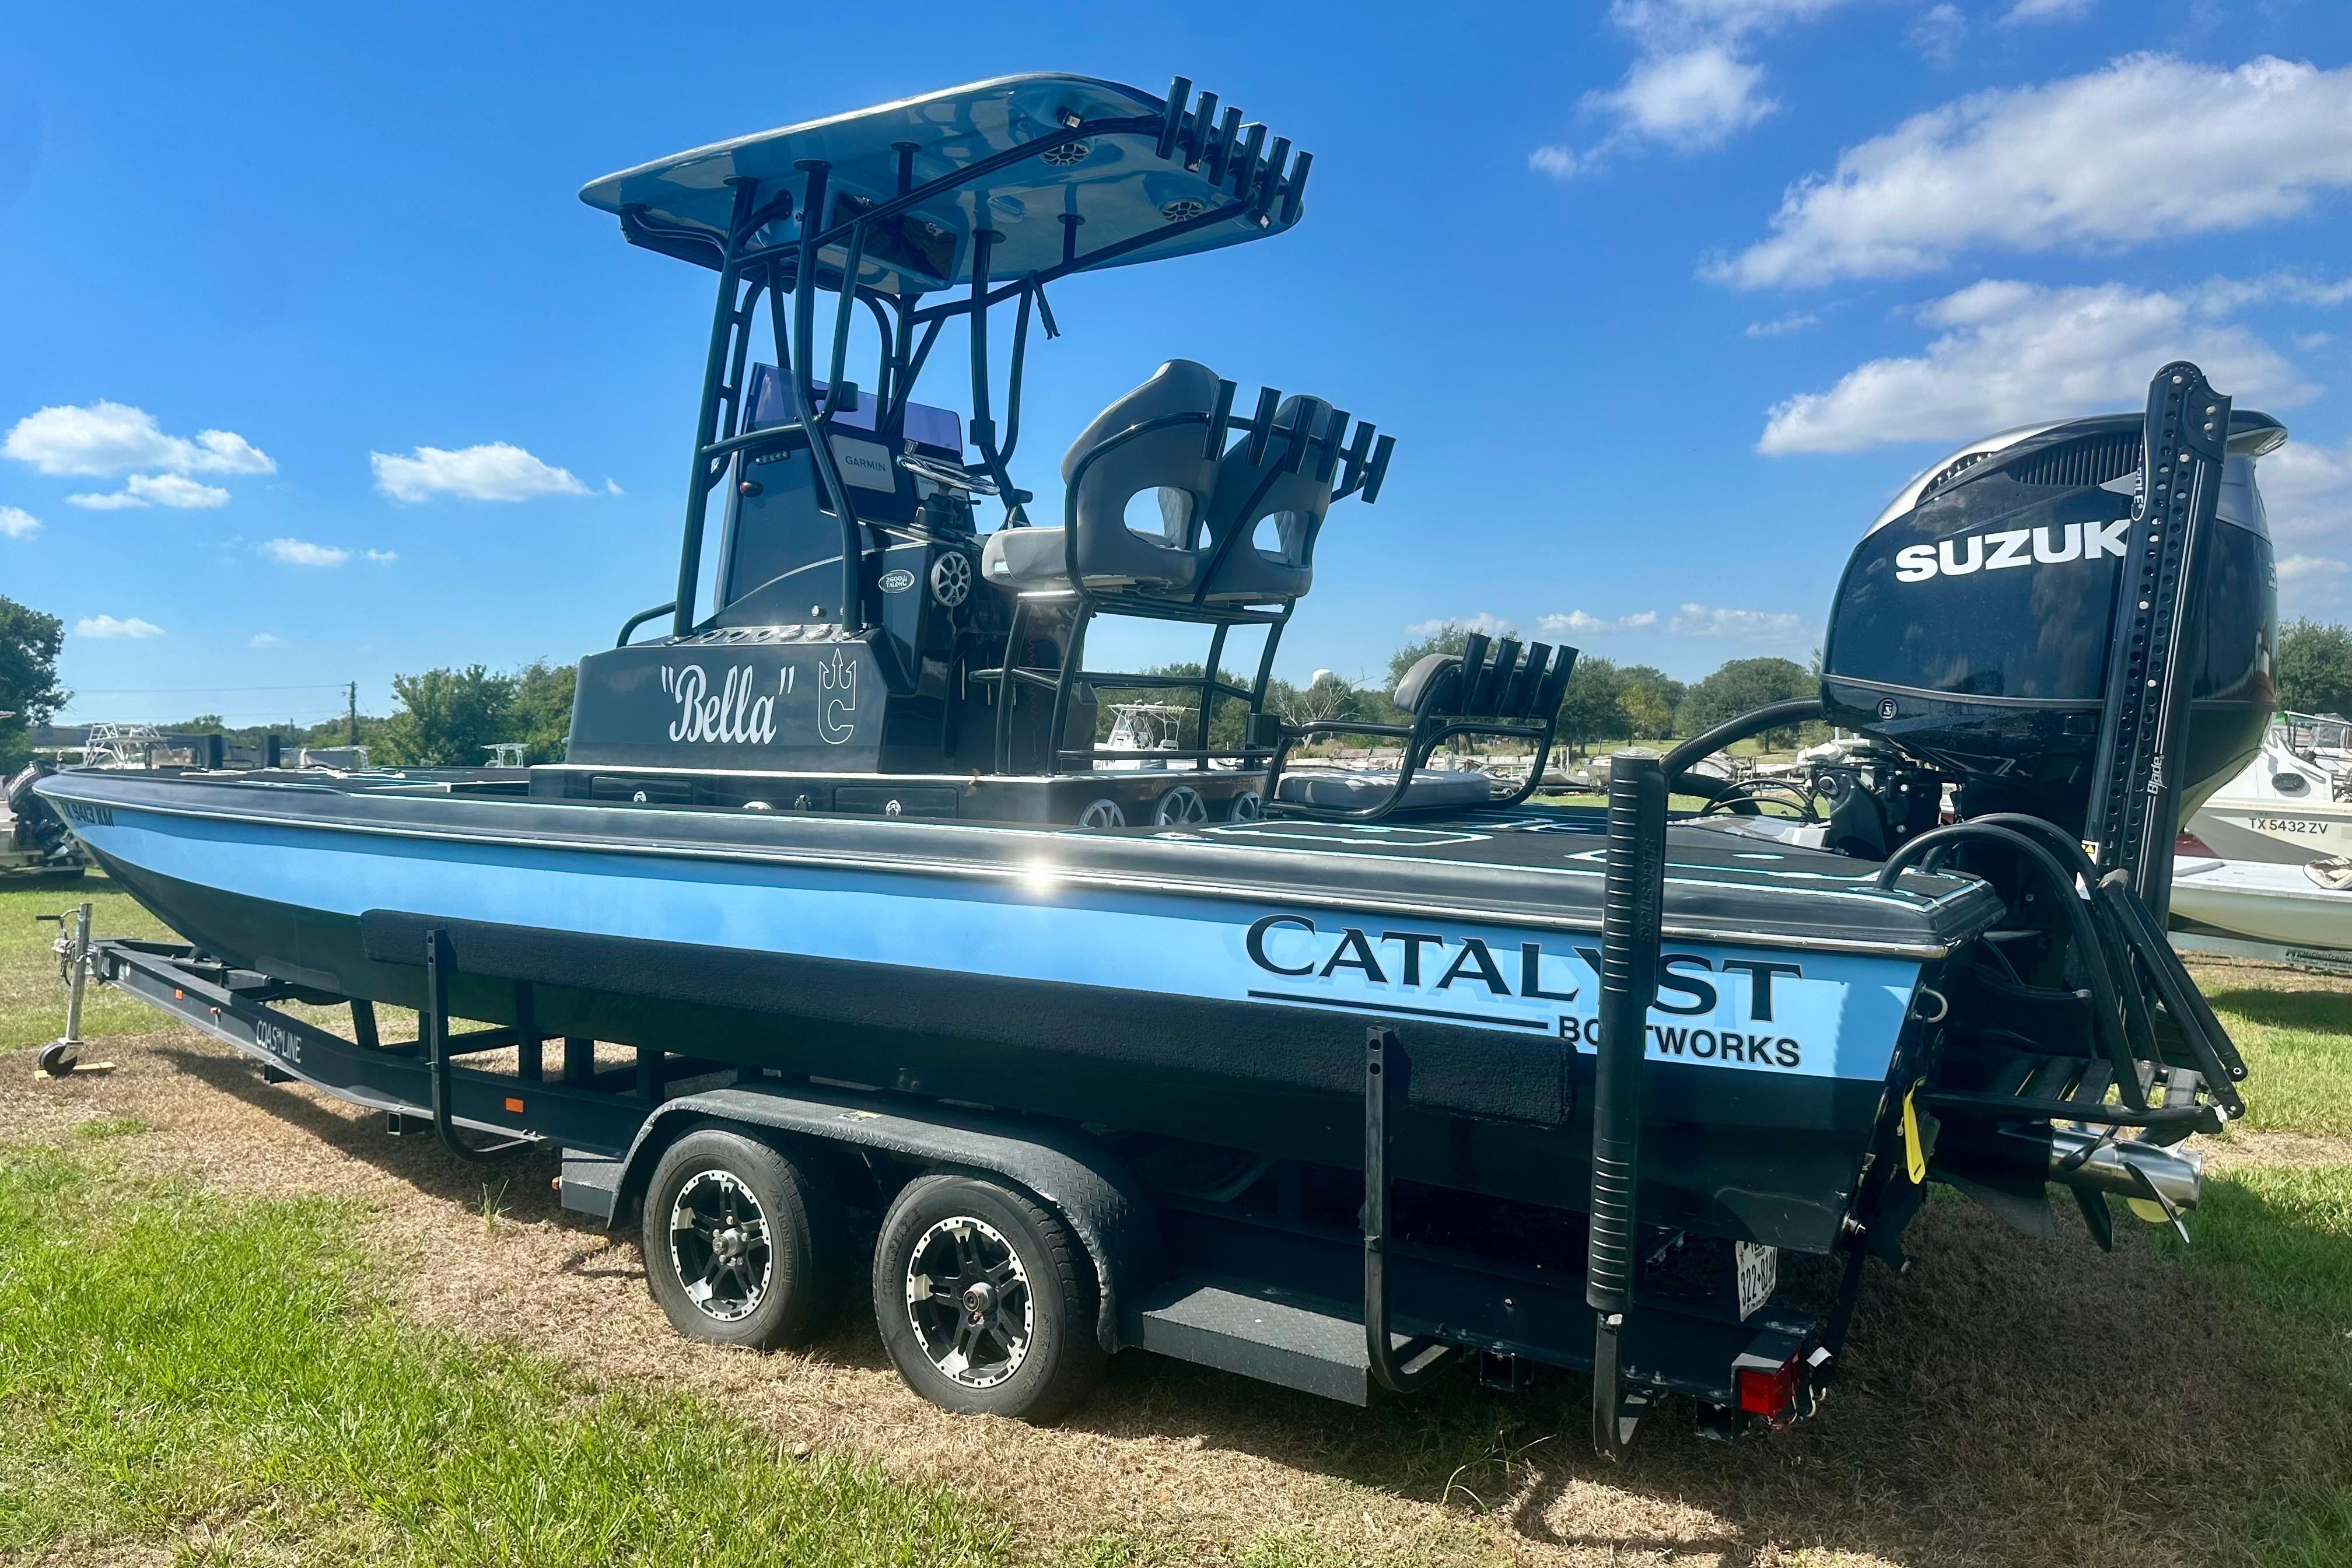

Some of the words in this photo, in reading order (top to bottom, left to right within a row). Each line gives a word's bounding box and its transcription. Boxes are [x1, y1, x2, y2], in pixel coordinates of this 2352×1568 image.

[845, 455, 886, 472] GARMIN
[919, 477, 936, 485] GARM
[1895, 519, 2130, 583] SUZUK
[2146, 755, 2166, 795] Blade
[2248, 817, 2267, 830] TX
[2269, 820, 2305, 833] 5432
[2308, 822, 2328, 834] ZV
[1559, 1015, 1801, 1068] BOWORKS
[1741, 1264, 1757, 1307] 322
